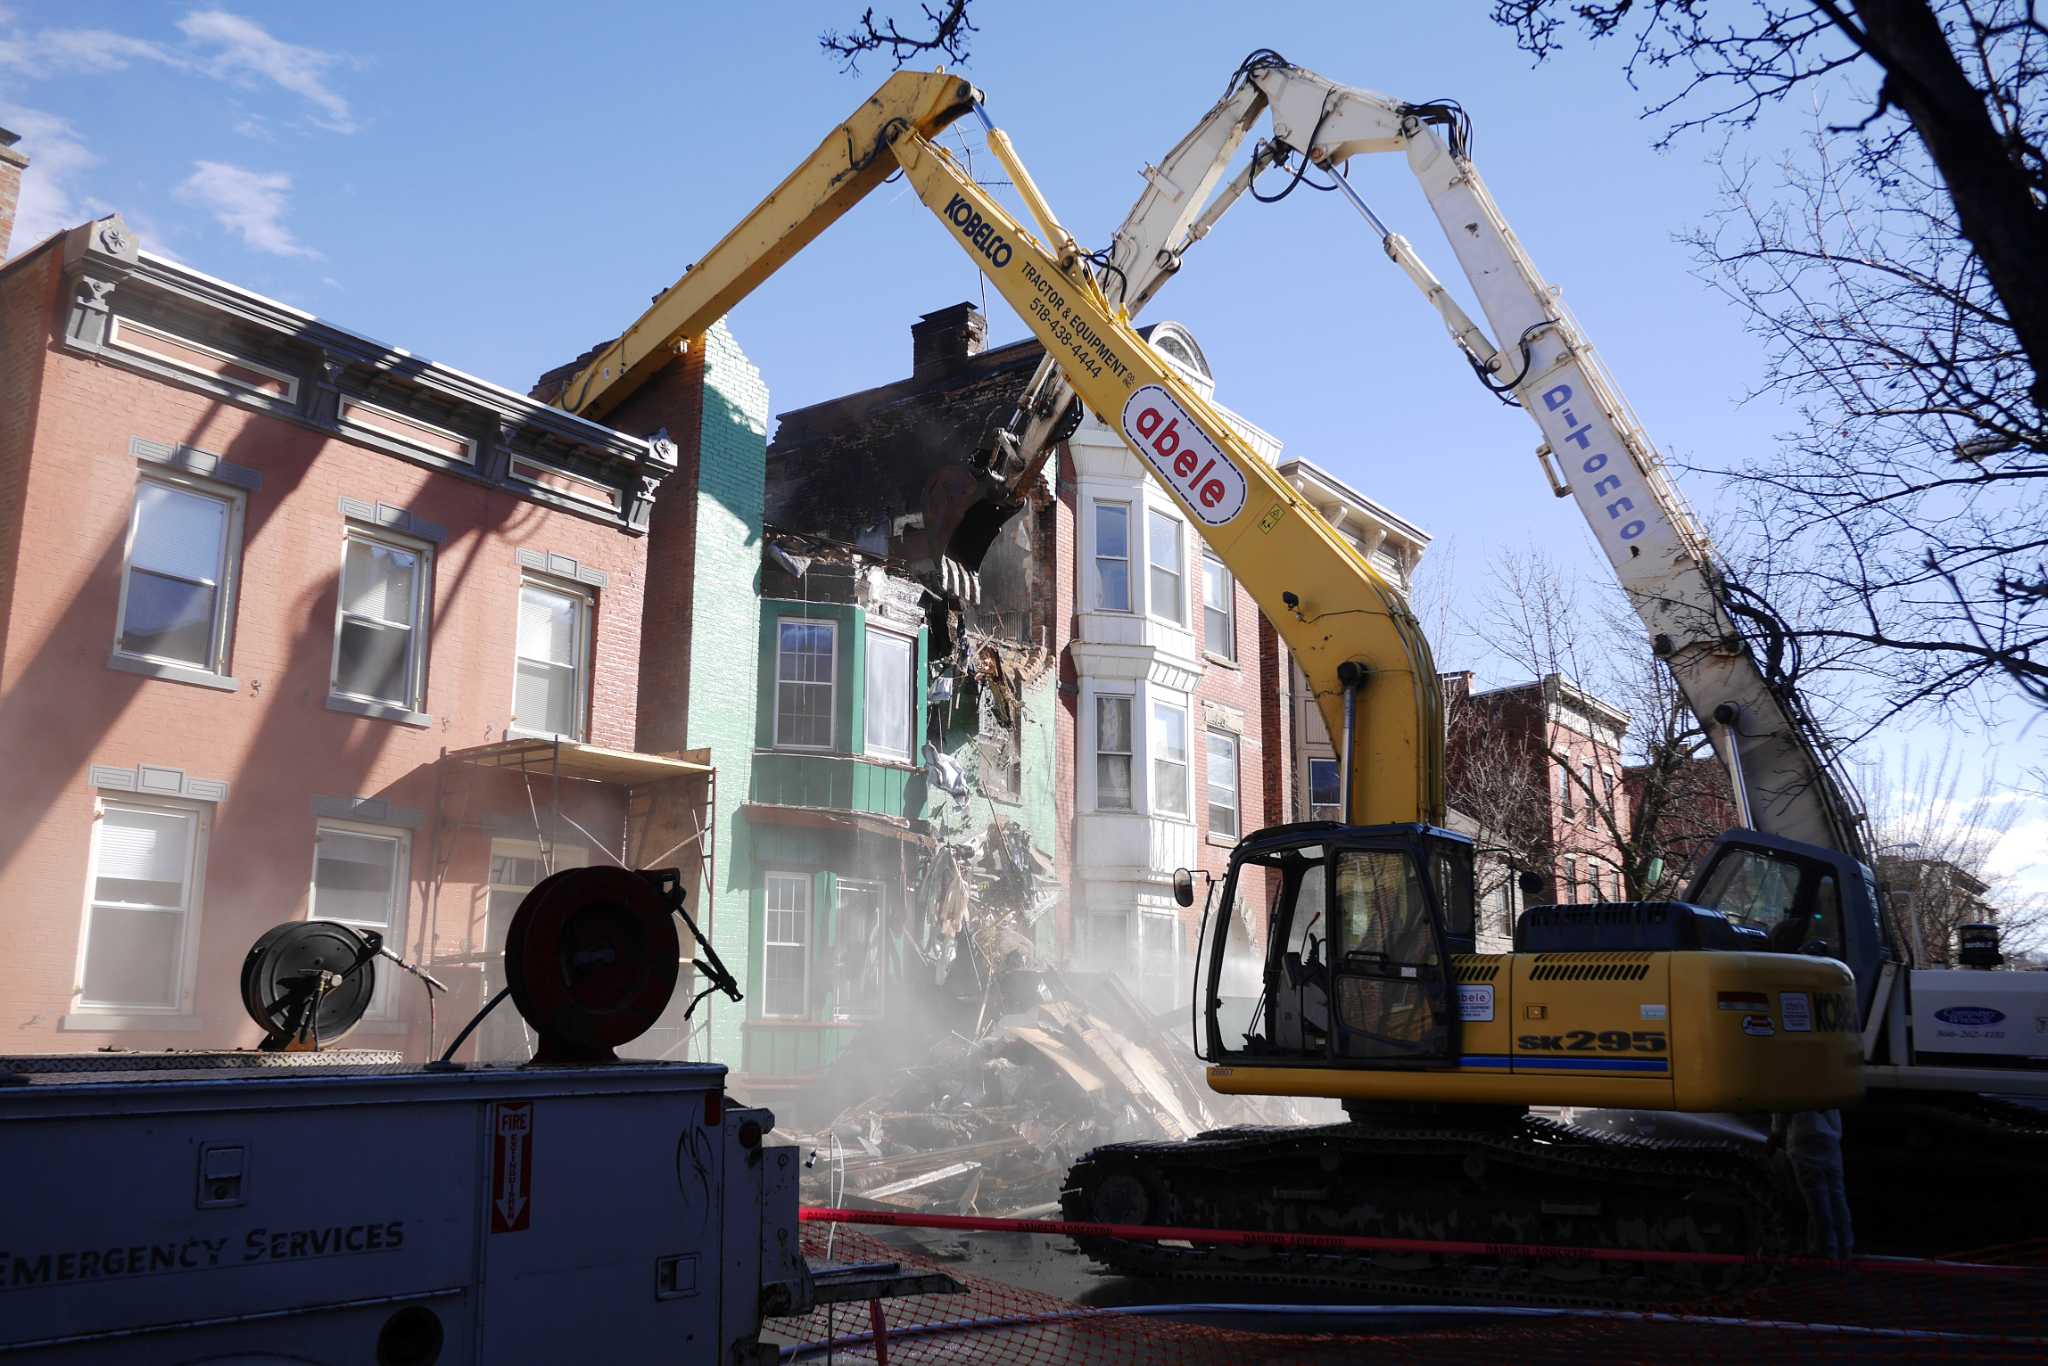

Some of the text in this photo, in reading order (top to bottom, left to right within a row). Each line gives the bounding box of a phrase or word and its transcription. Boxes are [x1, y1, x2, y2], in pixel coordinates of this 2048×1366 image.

[943, 192, 1013, 270] KOBELCO
[1020, 261, 1128, 377] TRACTOR & EQUIPMENT
[1029, 296, 1102, 378] 518-438-4444
[1136, 405, 1227, 509] abele
[1541, 384, 1646, 541] DiTonno
[1518, 1030, 1666, 1051] SK295
[502, 1113, 528, 1131] FIRE
[243, 1221, 404, 1262] SERVICES
